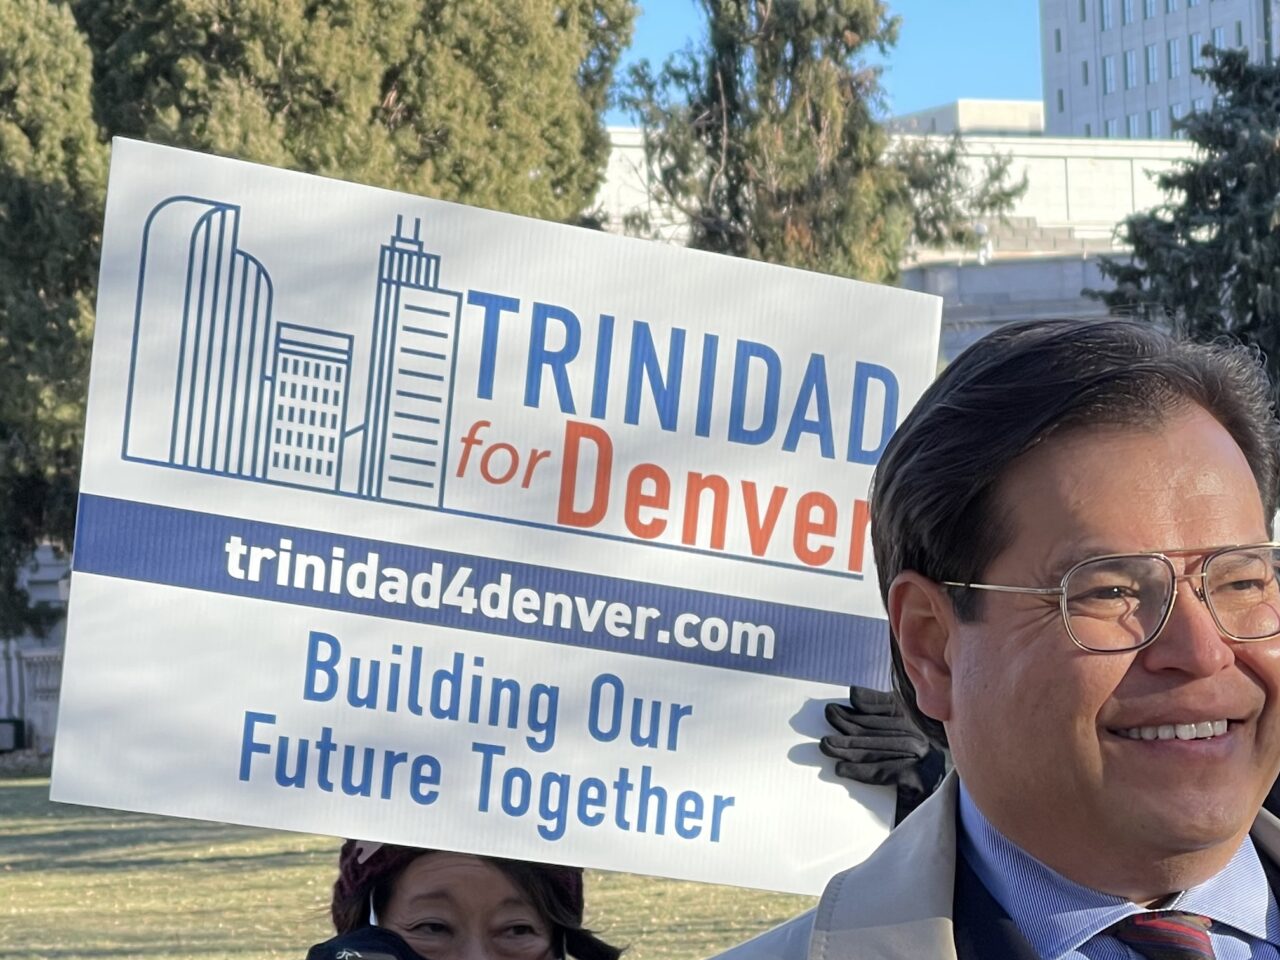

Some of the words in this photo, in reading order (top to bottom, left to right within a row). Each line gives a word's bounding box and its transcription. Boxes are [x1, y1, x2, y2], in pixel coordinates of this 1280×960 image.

[467, 290, 900, 465] TRINIDAD
[456, 420, 551, 488] for
[558, 421, 871, 573] Denver
[224, 534, 777, 660] trinidad4denver.com
[303, 631, 559, 753] Building
[588, 673, 693, 752] Our
[239, 710, 442, 806] Future
[471, 741, 736, 842] Together
